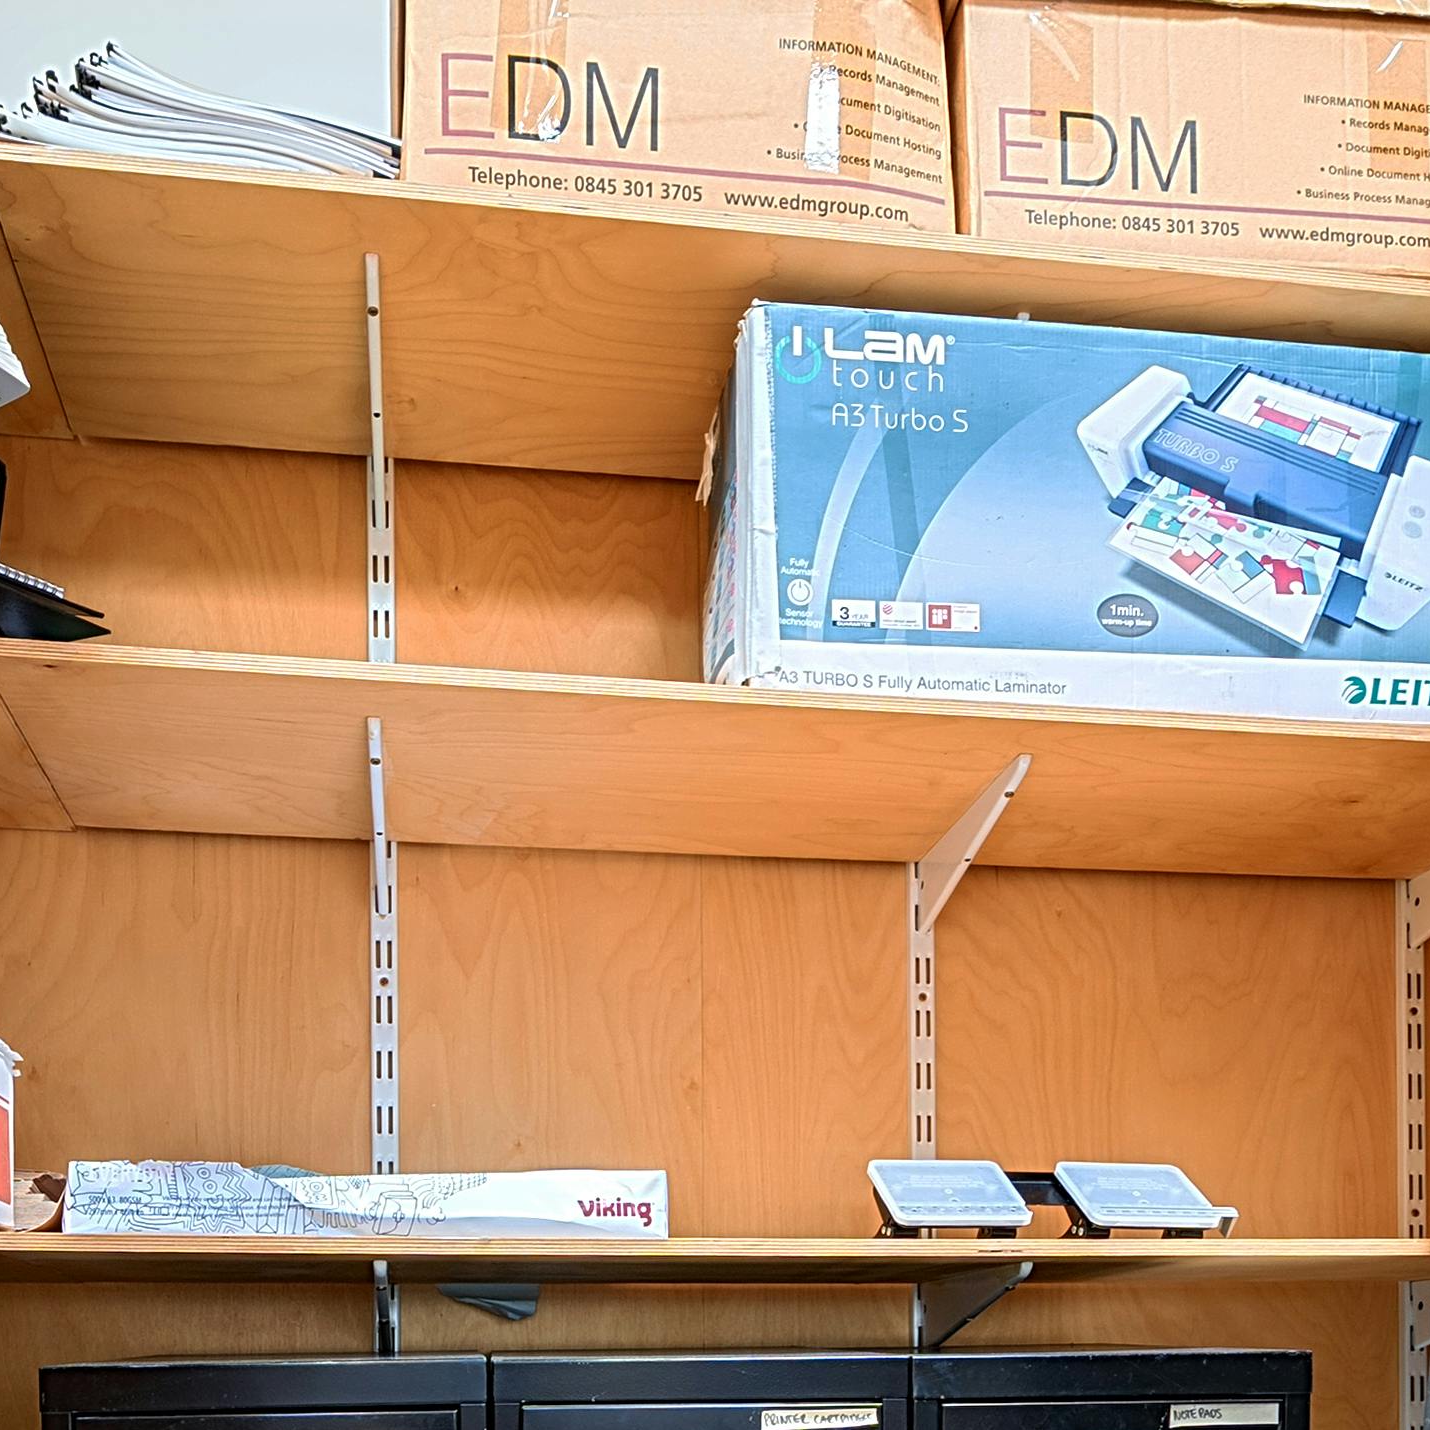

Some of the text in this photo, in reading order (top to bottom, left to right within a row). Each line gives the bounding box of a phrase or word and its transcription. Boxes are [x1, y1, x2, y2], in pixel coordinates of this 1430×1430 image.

[778, 38, 941, 88] INFORMATION MANAGEMENT:
[440, 52, 659, 152] EDM
[875, 74, 941, 107] Management
[1302, 93, 1381, 110] INFORMATION
[884, 103, 942, 133] Digitisation
[1348, 117, 1391, 131] Records
[845, 123, 901, 147] Document
[903, 137, 943, 161] Hosting
[998, 106, 1199, 195] EDM
[1345, 141, 1401, 156] Document
[873, 158, 943, 185] Management
[1327, 164, 1364, 178] Online
[1366, 167, 1421, 182] Document
[468, 166, 911, 223] Telephone: 0845 301 3705 www.edmgroup.com
[1304, 187, 1351, 201] Business
[1352, 191, 1393, 204] Process
[1024, 209, 1117, 231] Telephone:
[1120, 214, 1161, 232] 0845
[1166, 218, 1197, 234] 301
[1200, 220, 1241, 238] 3705
[832, 359, 945, 393] touch
[831, 402, 969, 434] A3 Turbo S
[1153, 427, 1240, 474] TURBO S
[839, 606, 851, 621] 3
[778, 669, 1068, 696] A3 TURBO S Fully Automatic Laminator
[576, 1197, 653, 1227] Viking
[763, 1412, 811, 1428] PRINTER
